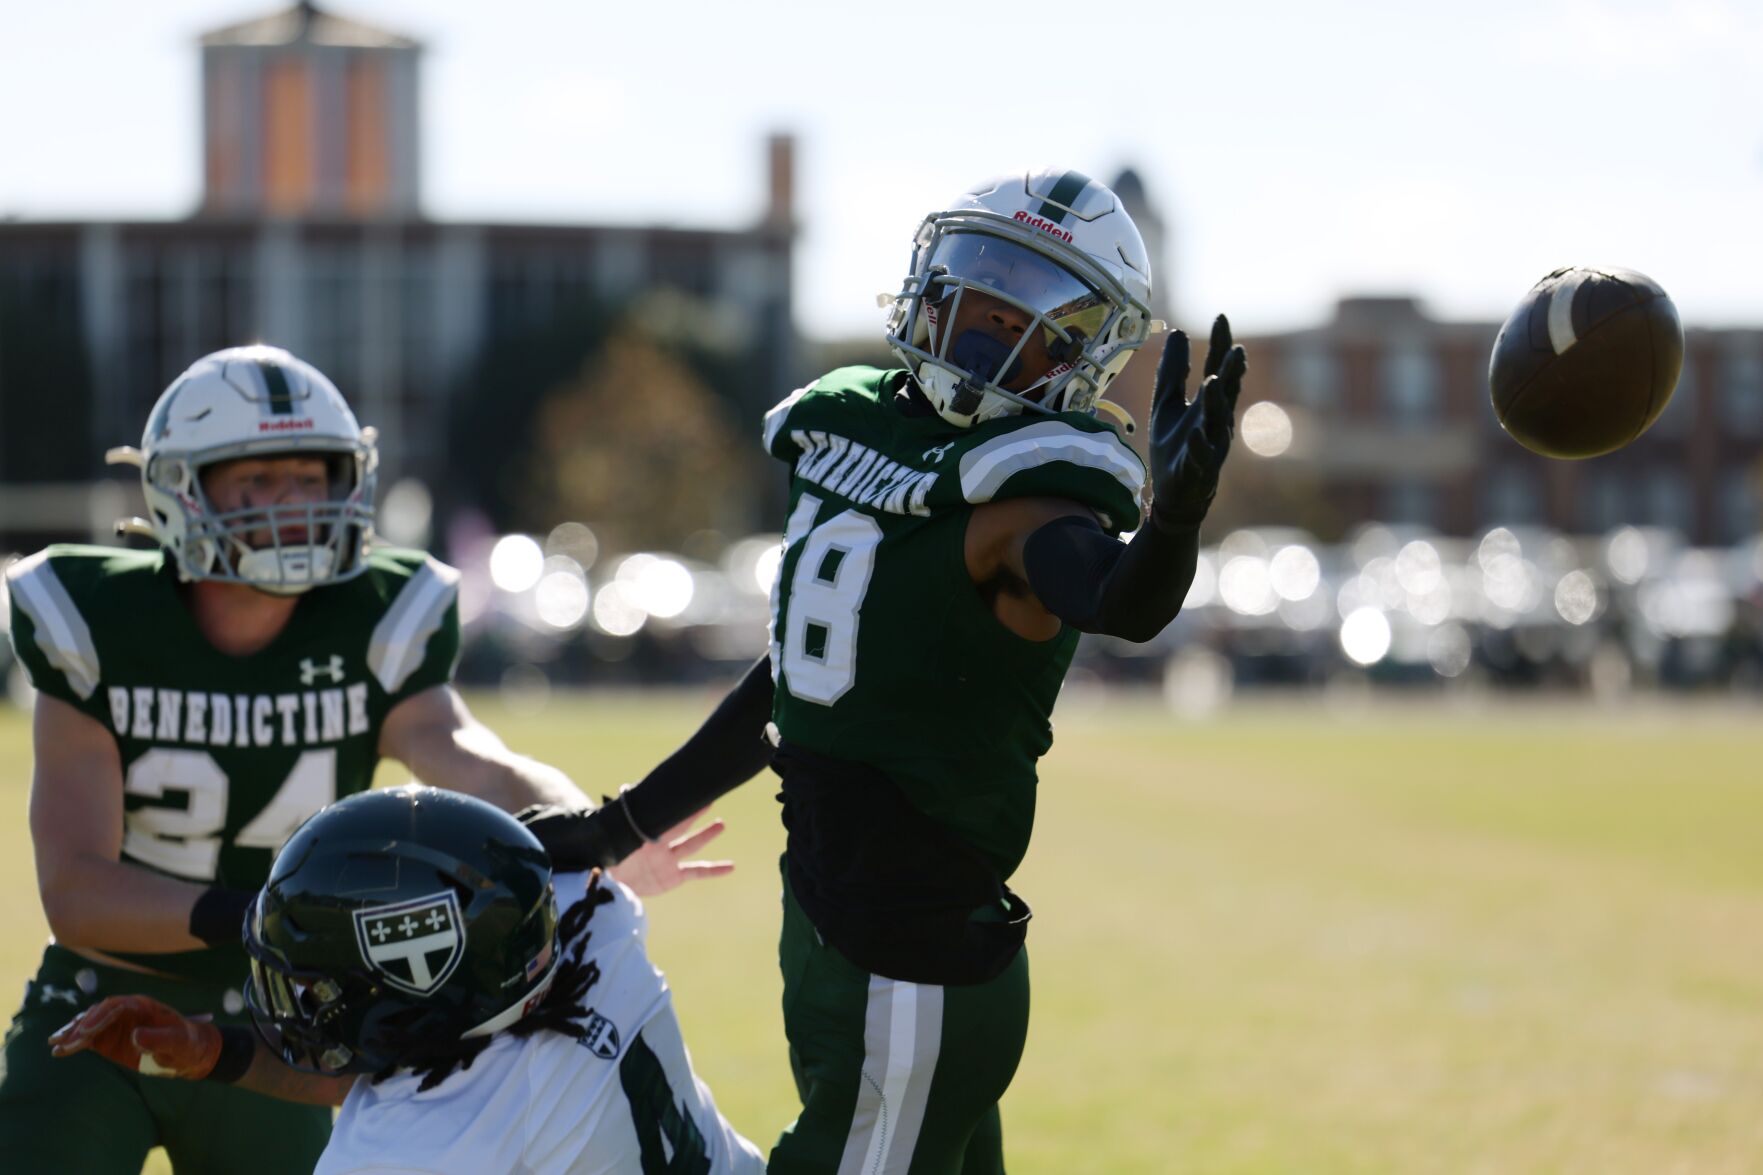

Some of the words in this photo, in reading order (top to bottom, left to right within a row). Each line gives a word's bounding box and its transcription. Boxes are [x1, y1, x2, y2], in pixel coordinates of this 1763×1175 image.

[1012, 210, 1073, 244] Riddell
[108, 681, 370, 747] BENEDICTINE
[121, 746, 337, 881] 24
